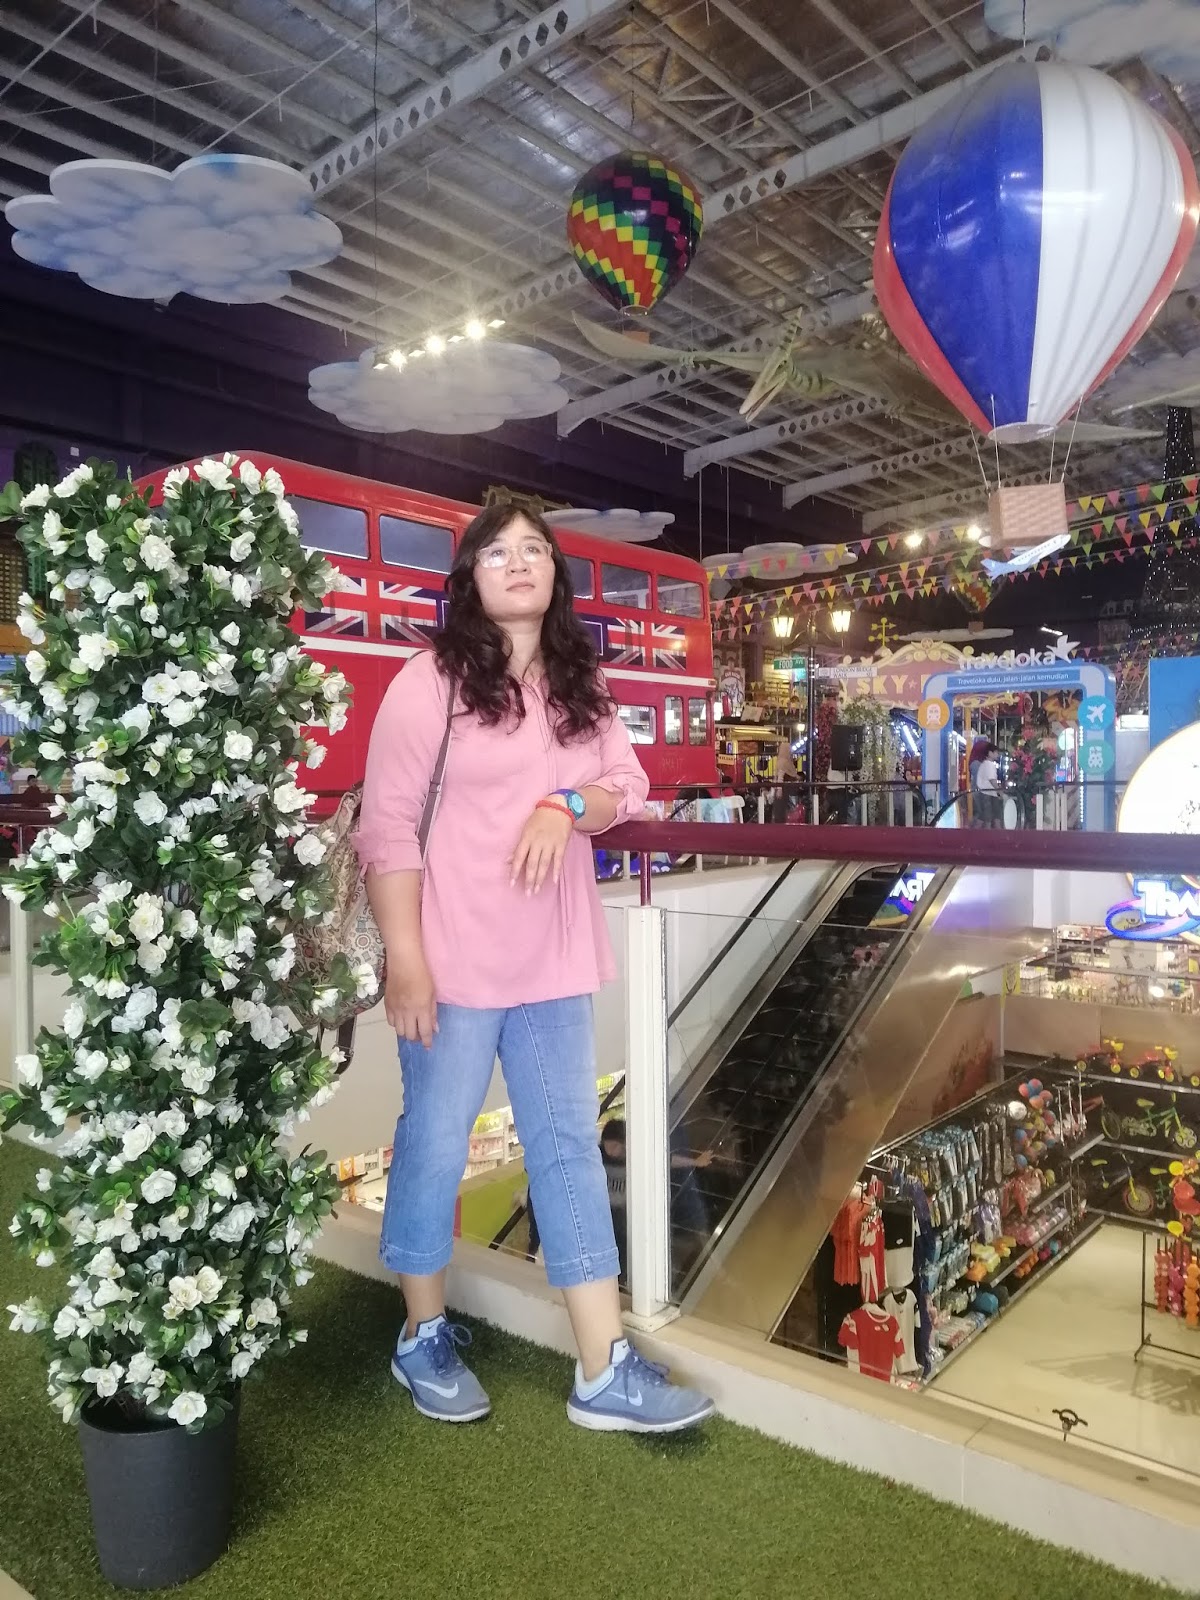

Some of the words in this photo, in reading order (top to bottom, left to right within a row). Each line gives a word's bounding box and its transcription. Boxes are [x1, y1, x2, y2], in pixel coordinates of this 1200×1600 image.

[778, 659, 793, 669] FOOD
[959, 647, 1056, 671] traveloka
[856, 674, 909, 696] SKY
[958, 677, 986, 685] Traveloka
[1003, 675, 1036, 683] jalan-jalan
[1037, 672, 1069, 680] kemudian
